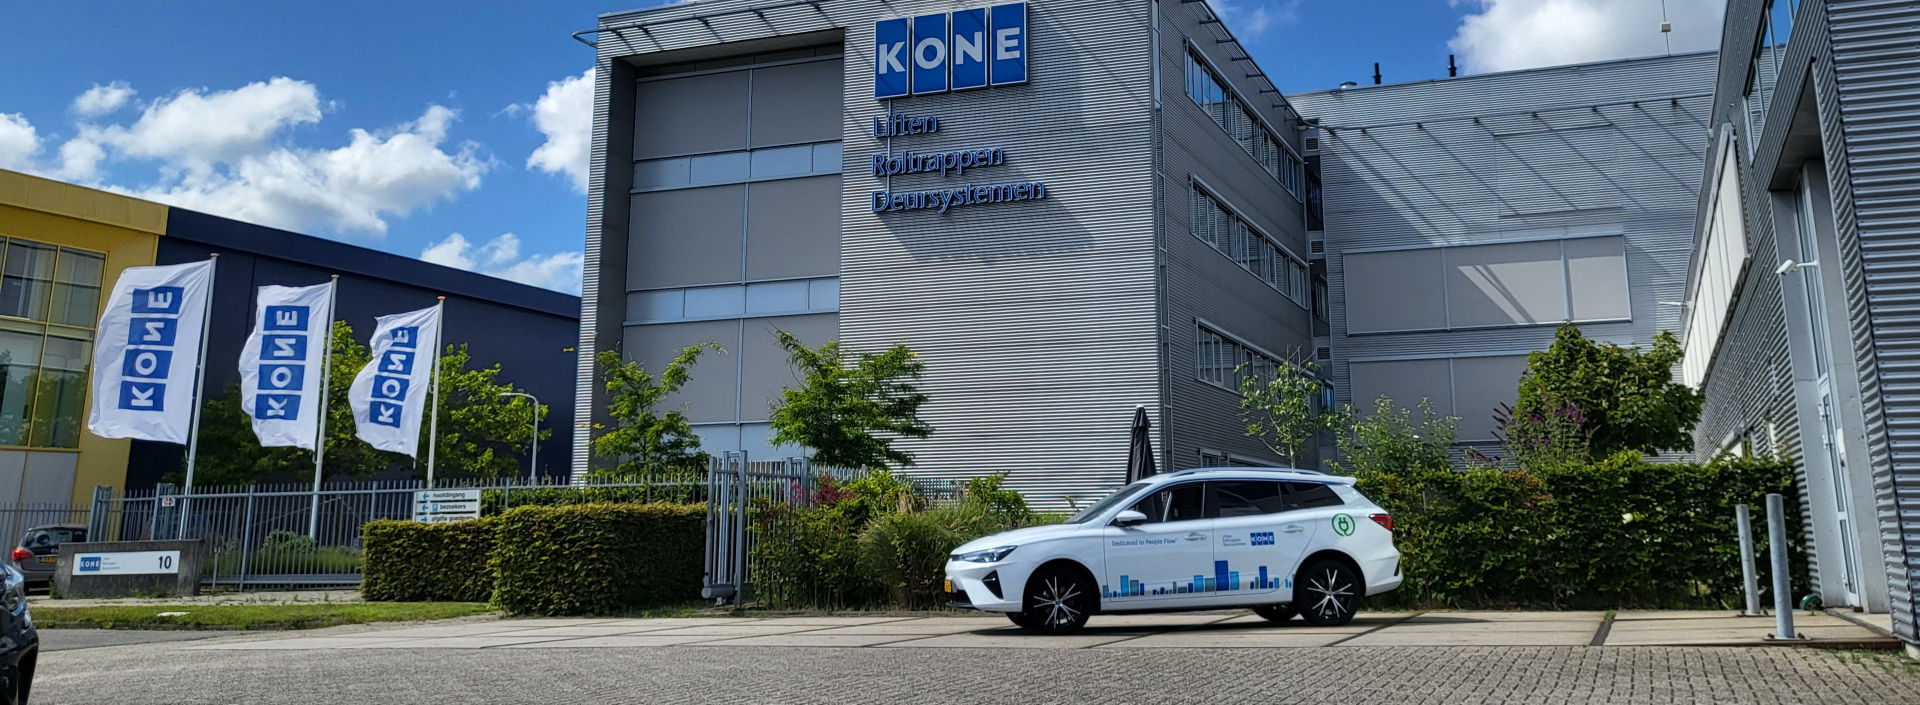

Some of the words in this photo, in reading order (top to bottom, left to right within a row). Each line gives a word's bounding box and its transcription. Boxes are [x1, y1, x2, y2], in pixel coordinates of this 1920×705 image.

[878, 26, 1021, 75] KONE
[873, 113, 938, 138] Liften
[871, 147, 1004, 176] Roltrappen
[871, 181, 1046, 214] Deursystemen
[1111, 539, 1138, 547] Dedicated
[80, 560, 100, 568] KONE
[158, 555, 172, 570] 10
